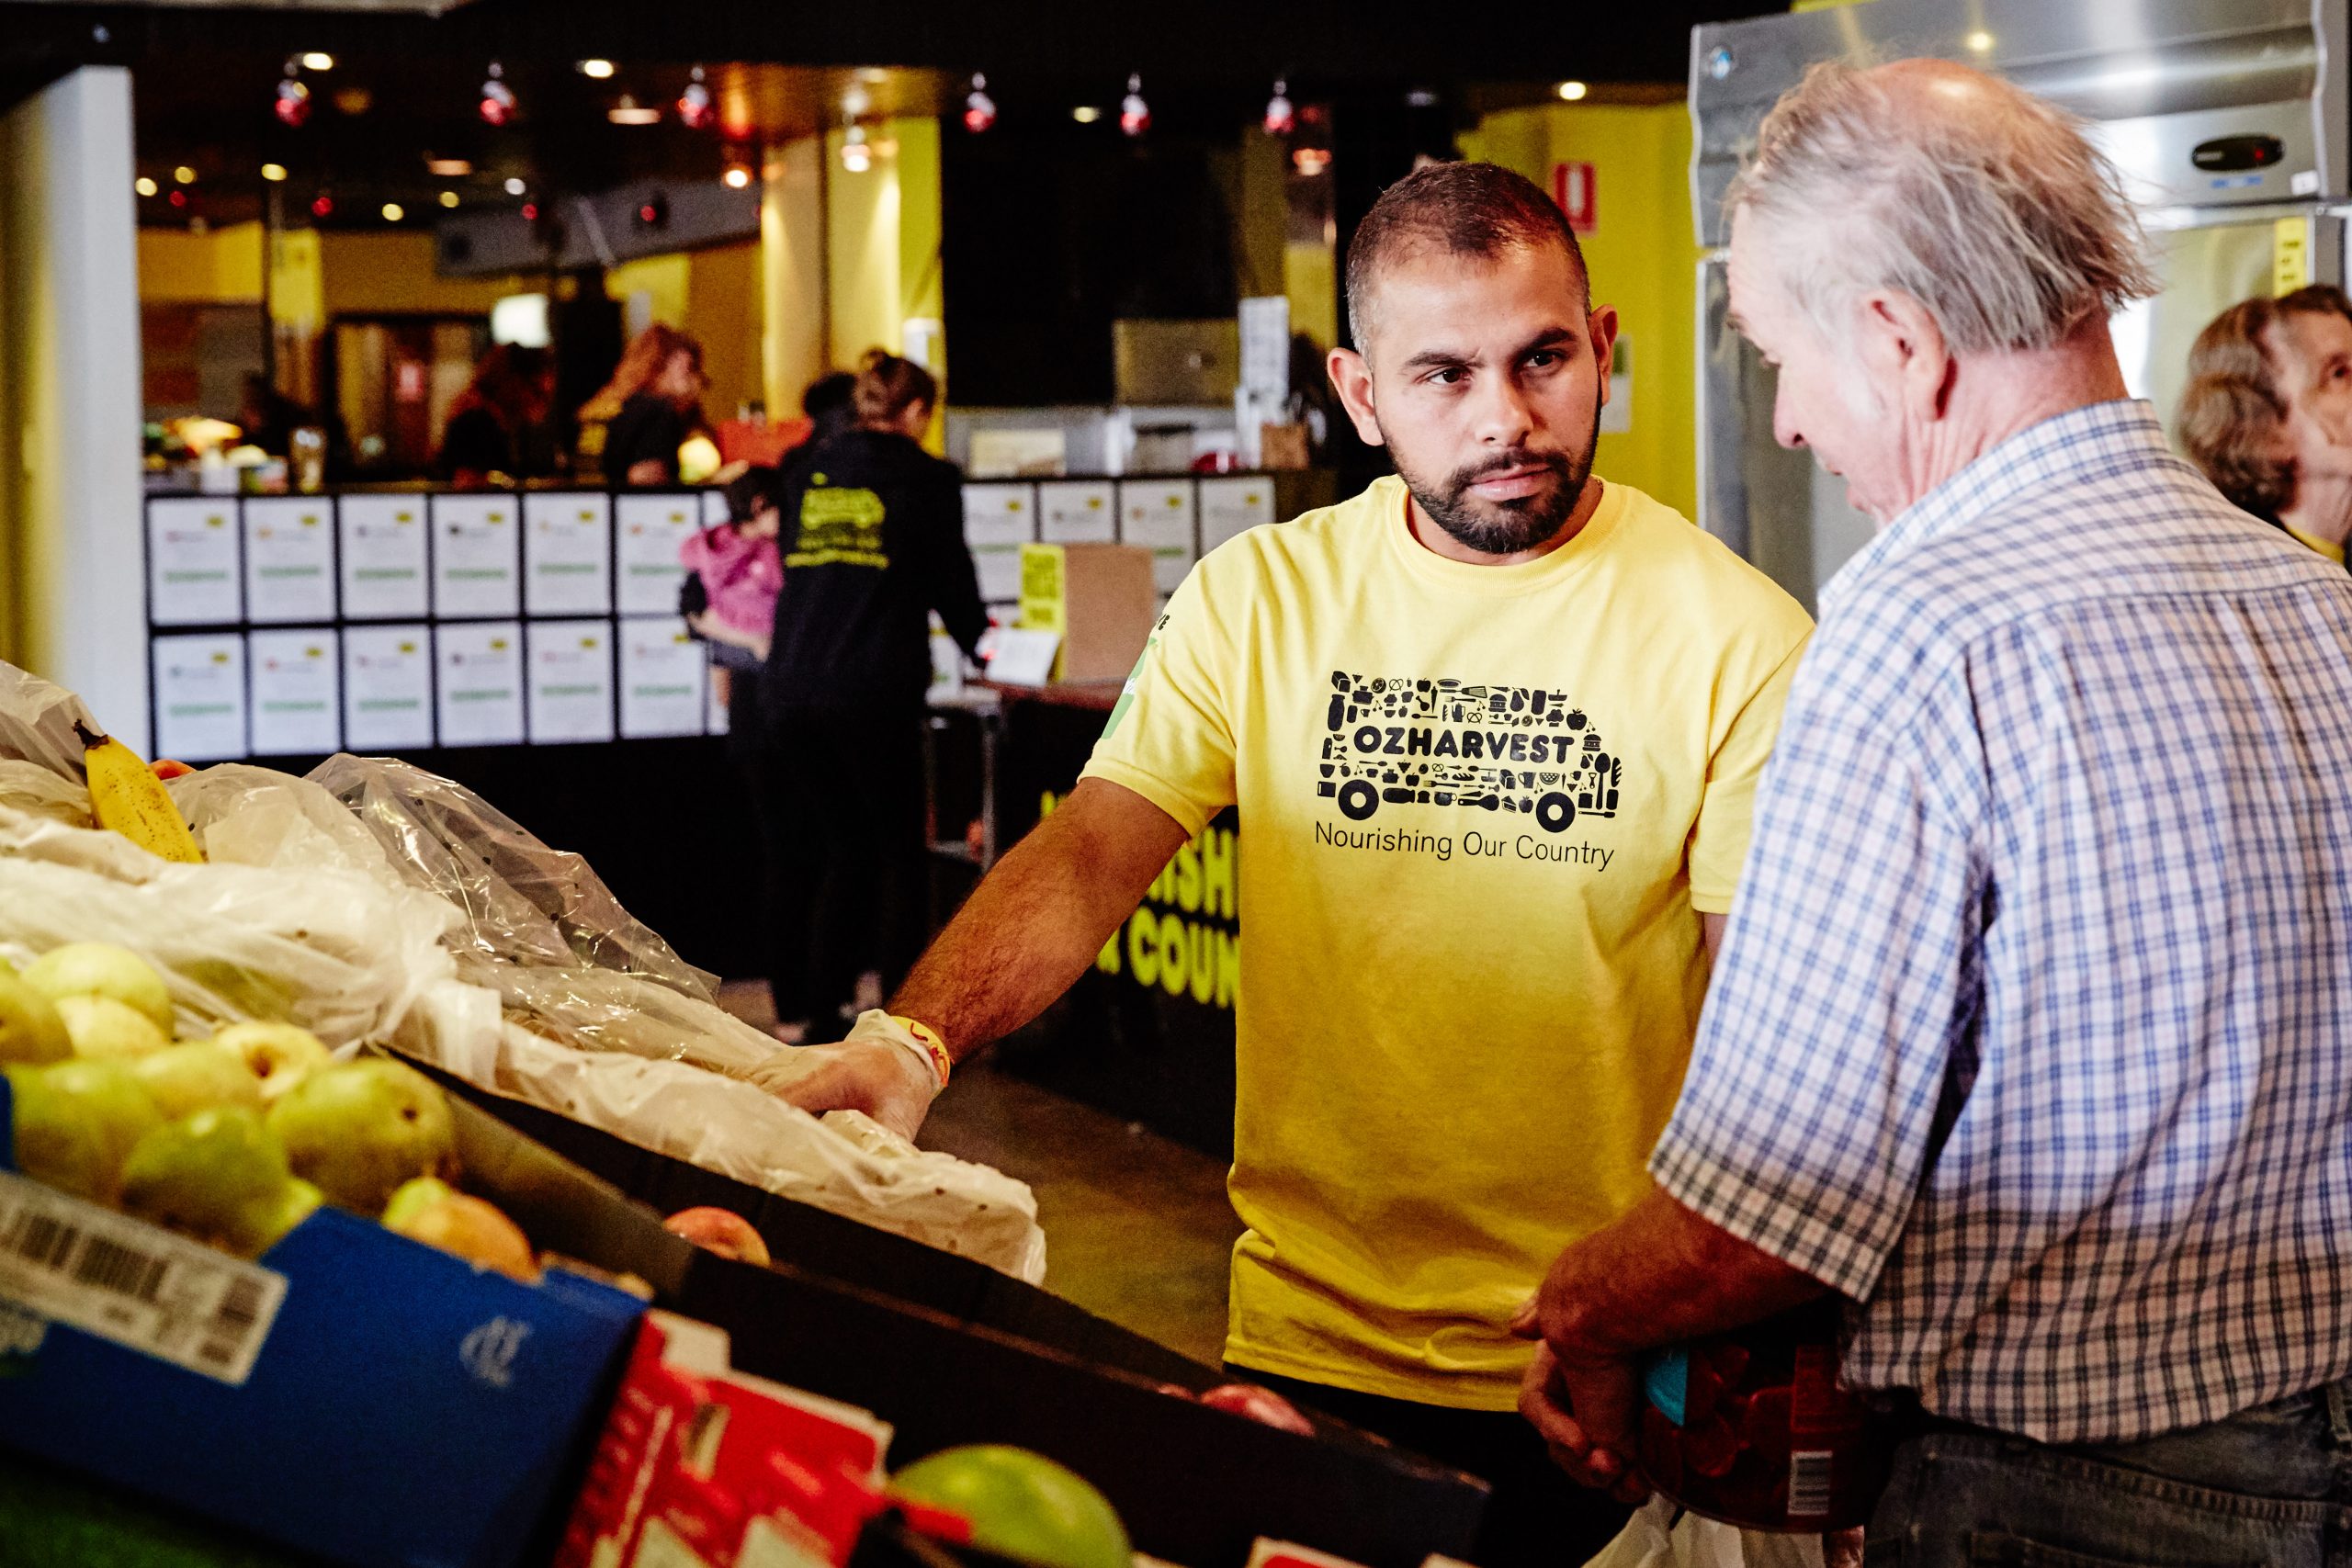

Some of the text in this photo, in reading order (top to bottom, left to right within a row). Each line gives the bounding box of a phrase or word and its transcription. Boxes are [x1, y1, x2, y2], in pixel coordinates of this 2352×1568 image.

[1353, 725, 1575, 764] OZHARVEST
[1316, 820, 1615, 873] Nourishing Our Country
